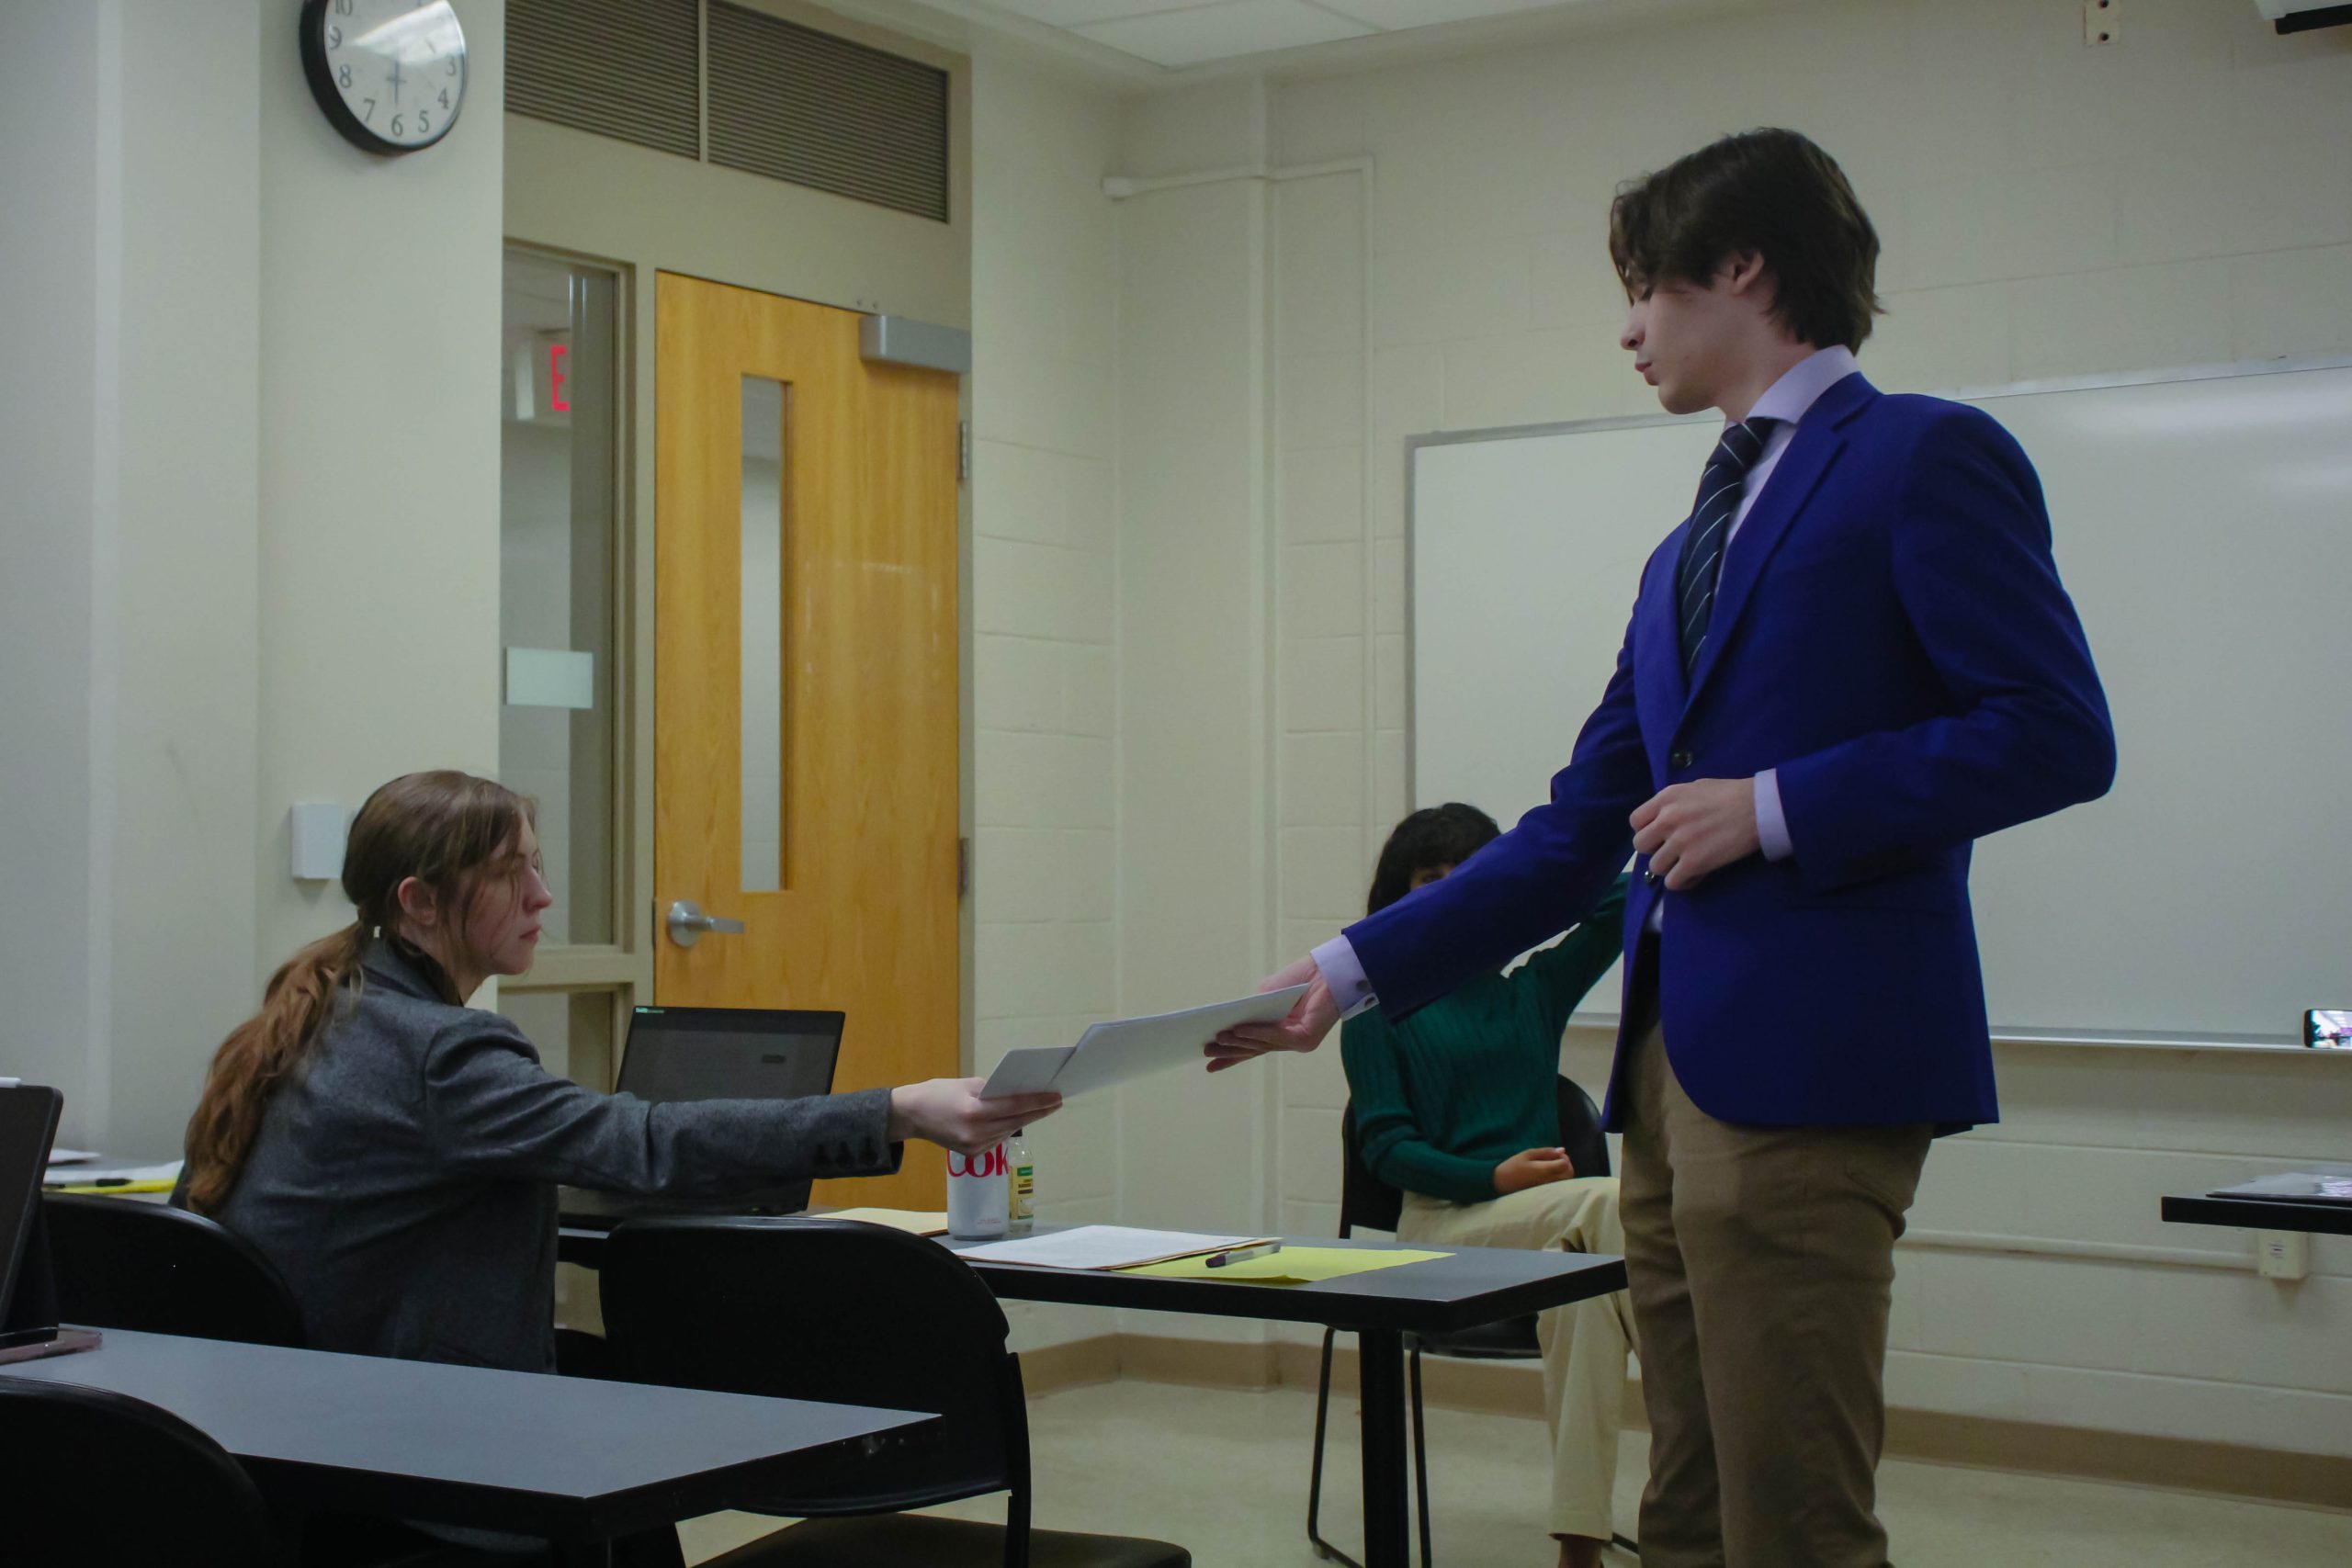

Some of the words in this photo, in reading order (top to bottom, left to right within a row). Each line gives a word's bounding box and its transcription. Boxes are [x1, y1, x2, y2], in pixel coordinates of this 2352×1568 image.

[334, 0, 353, 16] 10
[329, 26, 342, 50] 9
[339, 64, 352, 88] 8
[446, 55, 457, 76] 3
[363, 98, 376, 122] 7
[437, 88, 450, 109] 4
[391, 114, 403, 137] 6
[418, 110, 430, 133] 5
